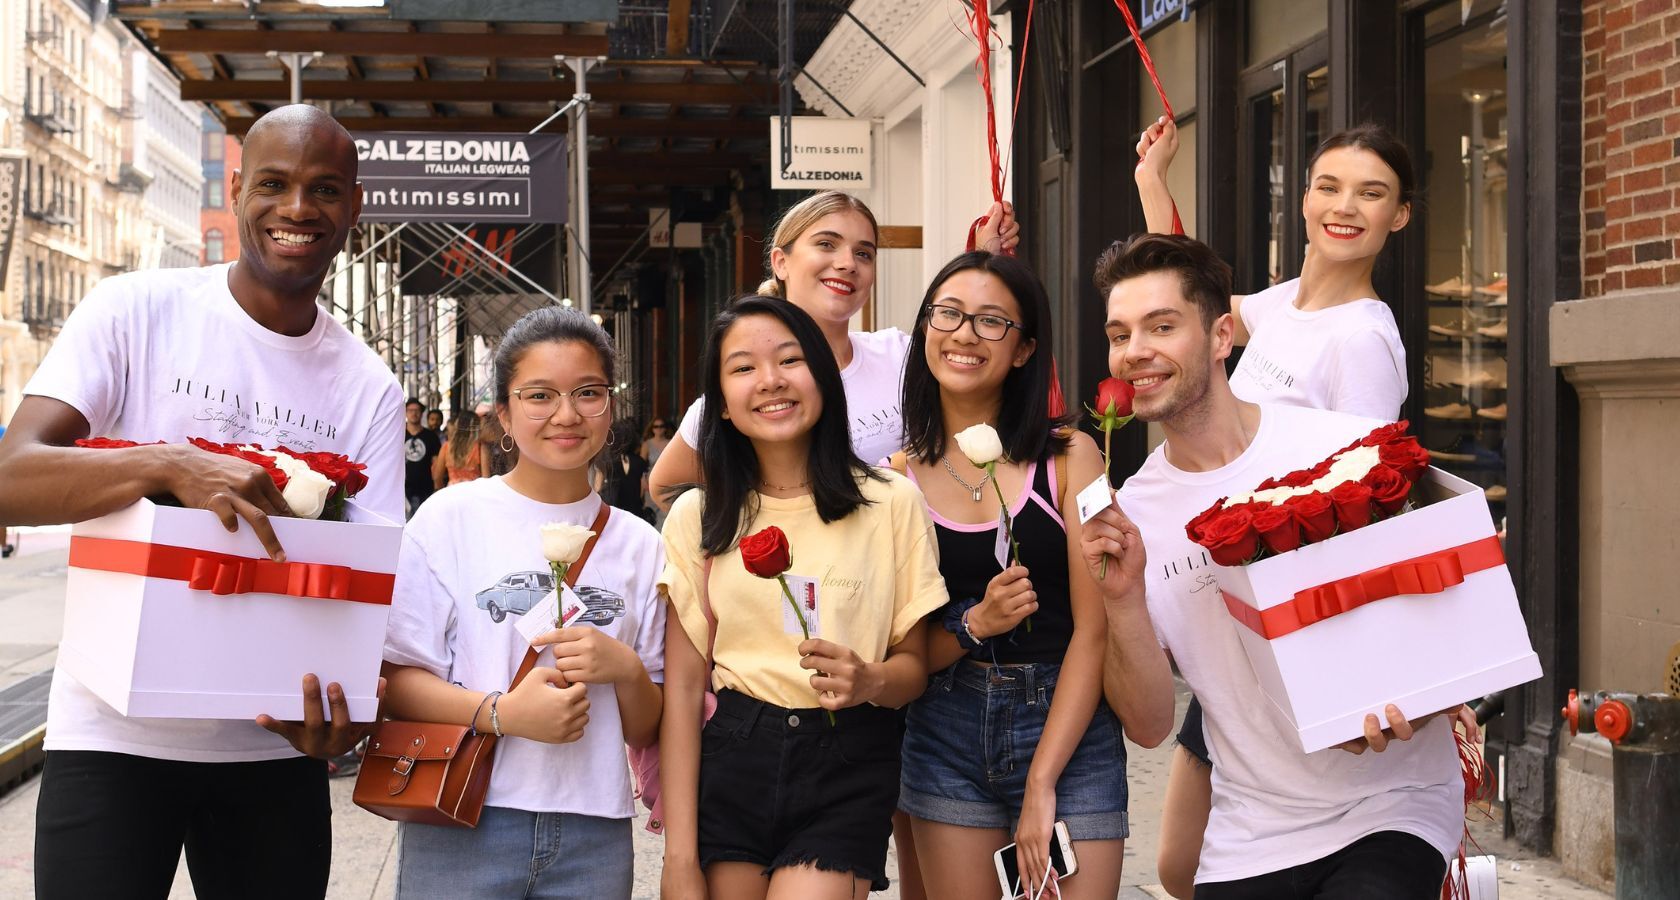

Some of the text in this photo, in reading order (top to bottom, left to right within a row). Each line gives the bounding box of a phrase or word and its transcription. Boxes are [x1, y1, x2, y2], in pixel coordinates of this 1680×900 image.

[355, 139, 531, 162] CALZEDONIA
[794, 145, 864, 154] timissimi
[425, 164, 530, 174] ITALIAN LEGWEAR
[781, 171, 863, 181] CALZEDONIA
[1164, 551, 1208, 580] JULI
[821, 565, 862, 600] honey
